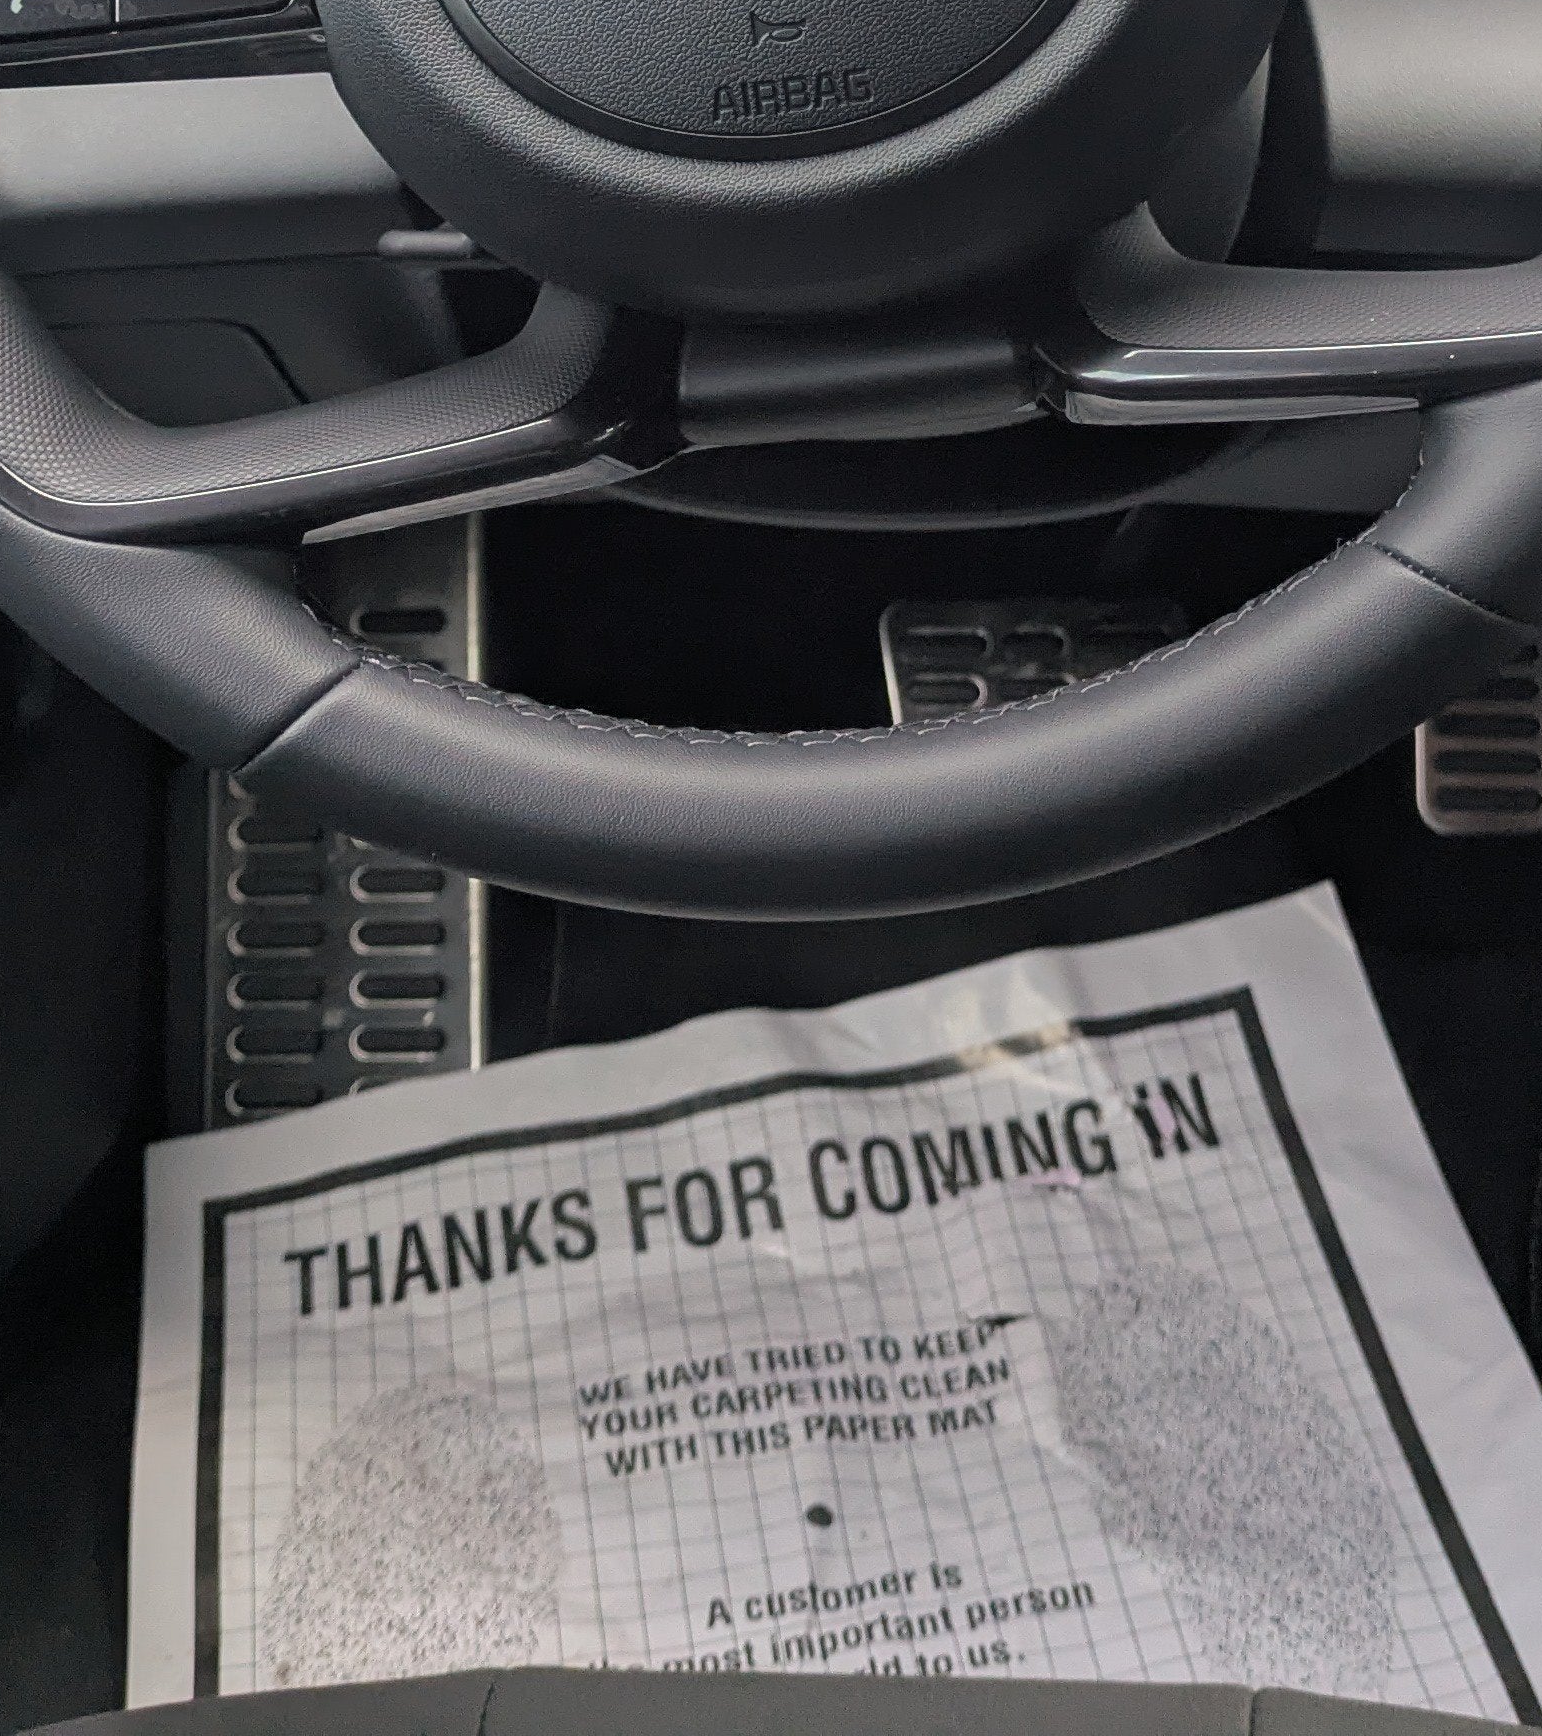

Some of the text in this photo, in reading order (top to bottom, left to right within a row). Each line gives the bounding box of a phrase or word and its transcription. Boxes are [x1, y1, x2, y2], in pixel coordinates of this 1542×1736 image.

[712, 68, 875, 121] AIRBAG
[285, 1187, 598, 1316] THANKS
[625, 1156, 783, 1253] FOR
[808, 1098, 1118, 1220] COMING
[578, 1317, 1002, 1407] WE HAVE TRIED TO KEEP
[579, 1357, 1010, 1442] YOUR CARPETING CLEAN
[606, 1397, 1000, 1478] WITH THIS PAPER MAT
[707, 1597, 732, 1630] A
[744, 1570, 916, 1621] customer
[769, 1605, 954, 1667] important
[966, 1579, 1096, 1631] person
[916, 1652, 954, 1676] to
[968, 1640, 1027, 1668] us.
